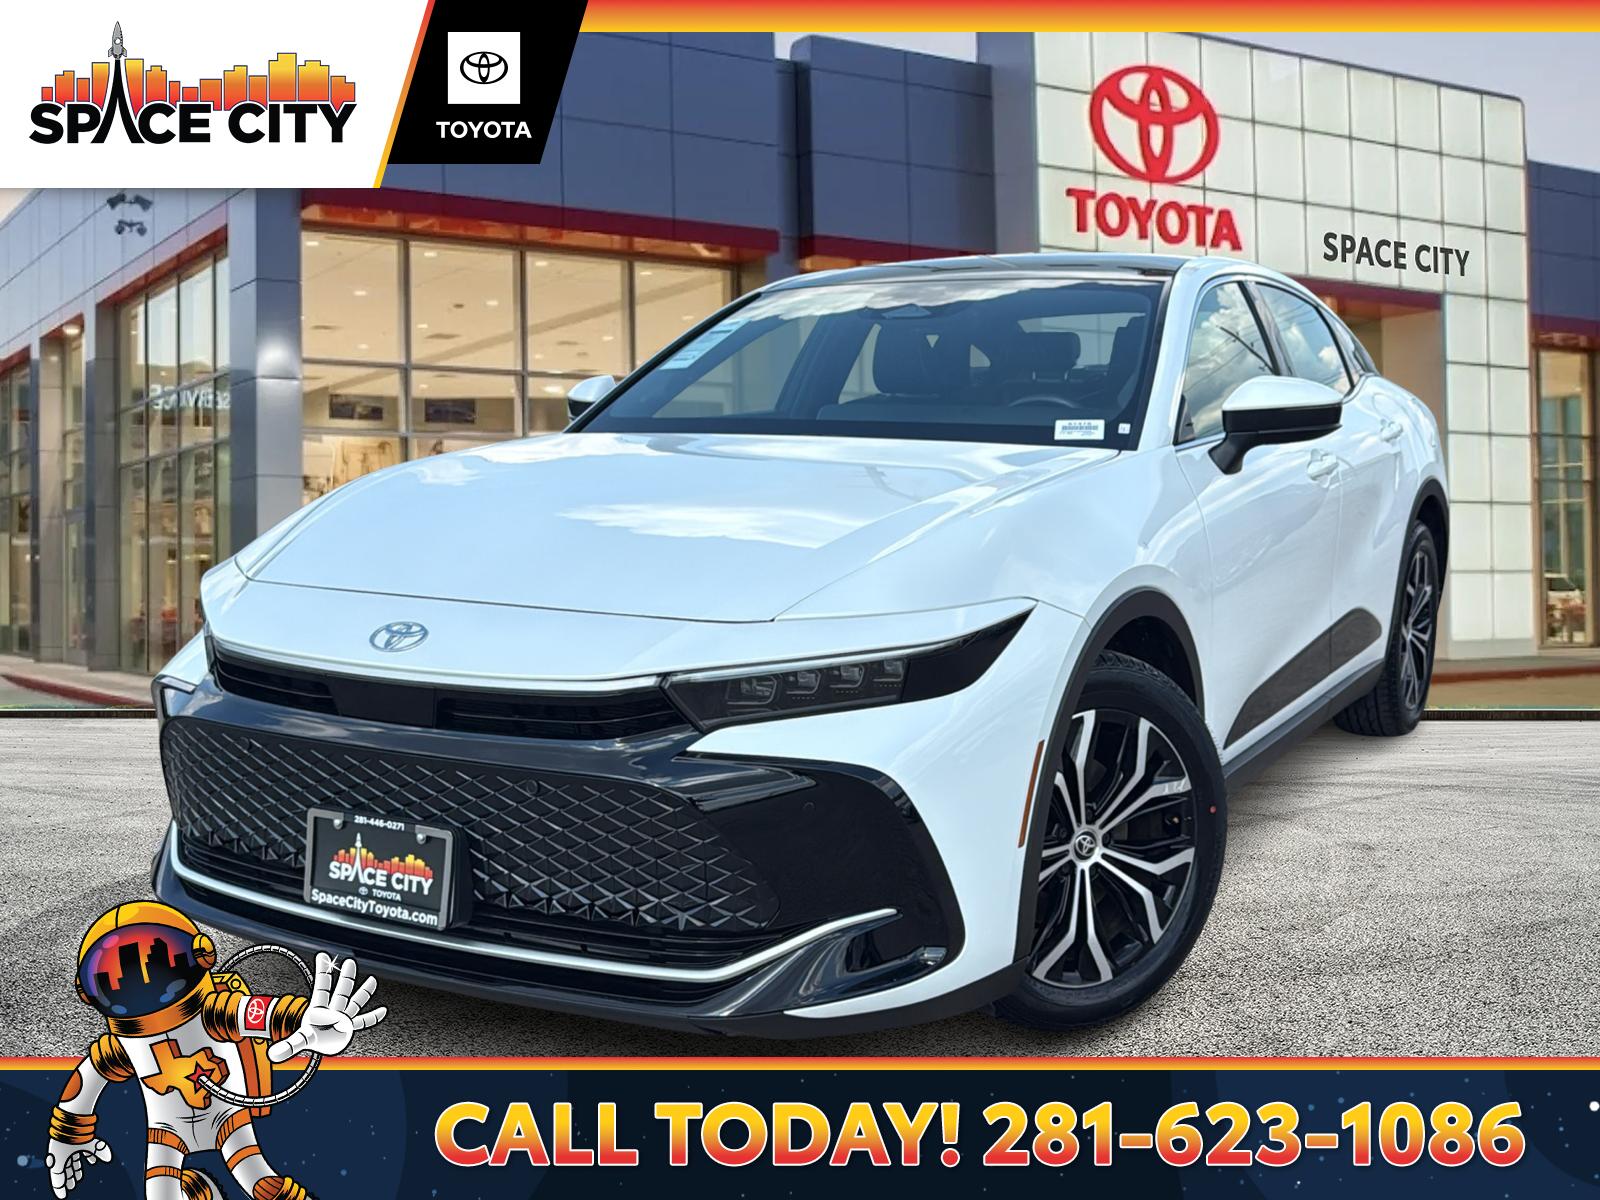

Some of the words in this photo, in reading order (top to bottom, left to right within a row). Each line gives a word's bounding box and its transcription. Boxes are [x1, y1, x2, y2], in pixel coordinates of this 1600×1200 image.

[1066, 187, 1242, 251] TOYOTA
[1322, 231, 1407, 270] SPACE
[1414, 243, 1470, 277] CITY
[328, 860, 388, 887] SPACE
[390, 872, 434, 896] CITY
[372, 888, 402, 901] TOYOTA
[311, 888, 439, 926] SpaceCityToyota.com
